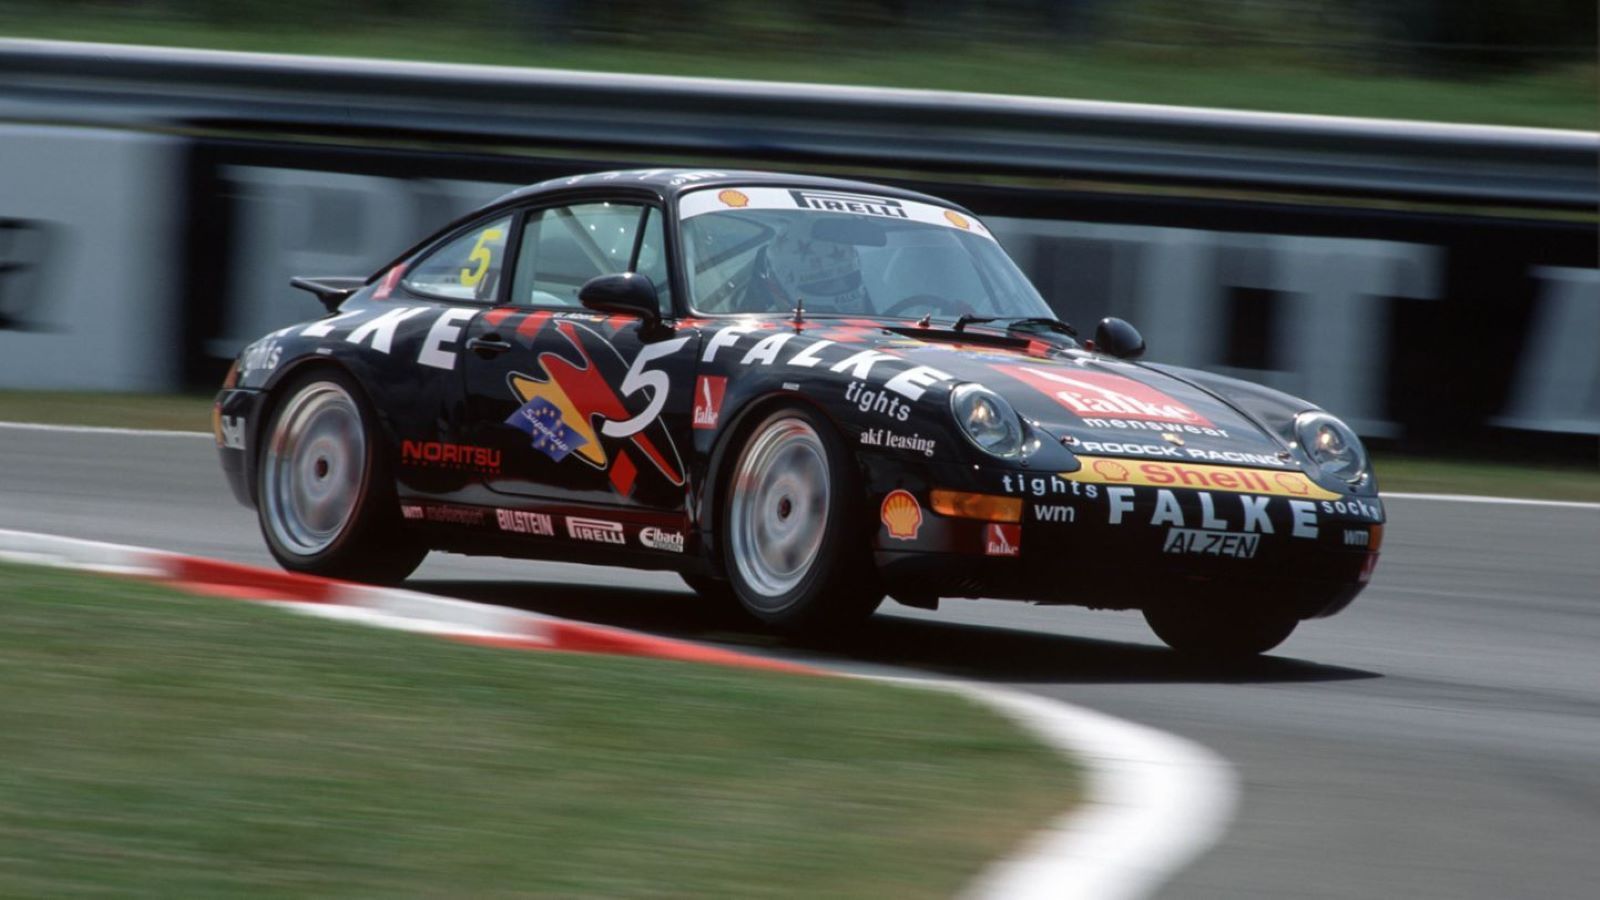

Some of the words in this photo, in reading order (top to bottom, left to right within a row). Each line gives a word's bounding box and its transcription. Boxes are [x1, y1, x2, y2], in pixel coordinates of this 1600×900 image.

[787, 189, 909, 218] PIRELLI
[461, 229, 502, 287] 5
[268, 306, 481, 370] LKE
[701, 325, 955, 401] FALKE
[601, 336, 692, 438] 5
[845, 381, 911, 422] tights
[1056, 390, 1199, 423] falke
[860, 428, 883, 447] akf
[886, 430, 936, 455] leasing
[1082, 417, 1230, 438] menswear
[402, 440, 500, 467] NORITSU
[1081, 440, 1183, 458] ROOCK
[1186, 447, 1281, 466] RACING
[1002, 474, 1099, 498] tights
[1139, 462, 1271, 492] Shell
[496, 508, 555, 537] BILSTEIN
[1106, 486, 1320, 539] FALKE
[1322, 498, 1379, 520] socks
[565, 516, 626, 545] PIRELLI
[639, 526, 684, 549] Eibach
[1166, 531, 1258, 558] ALZEN
